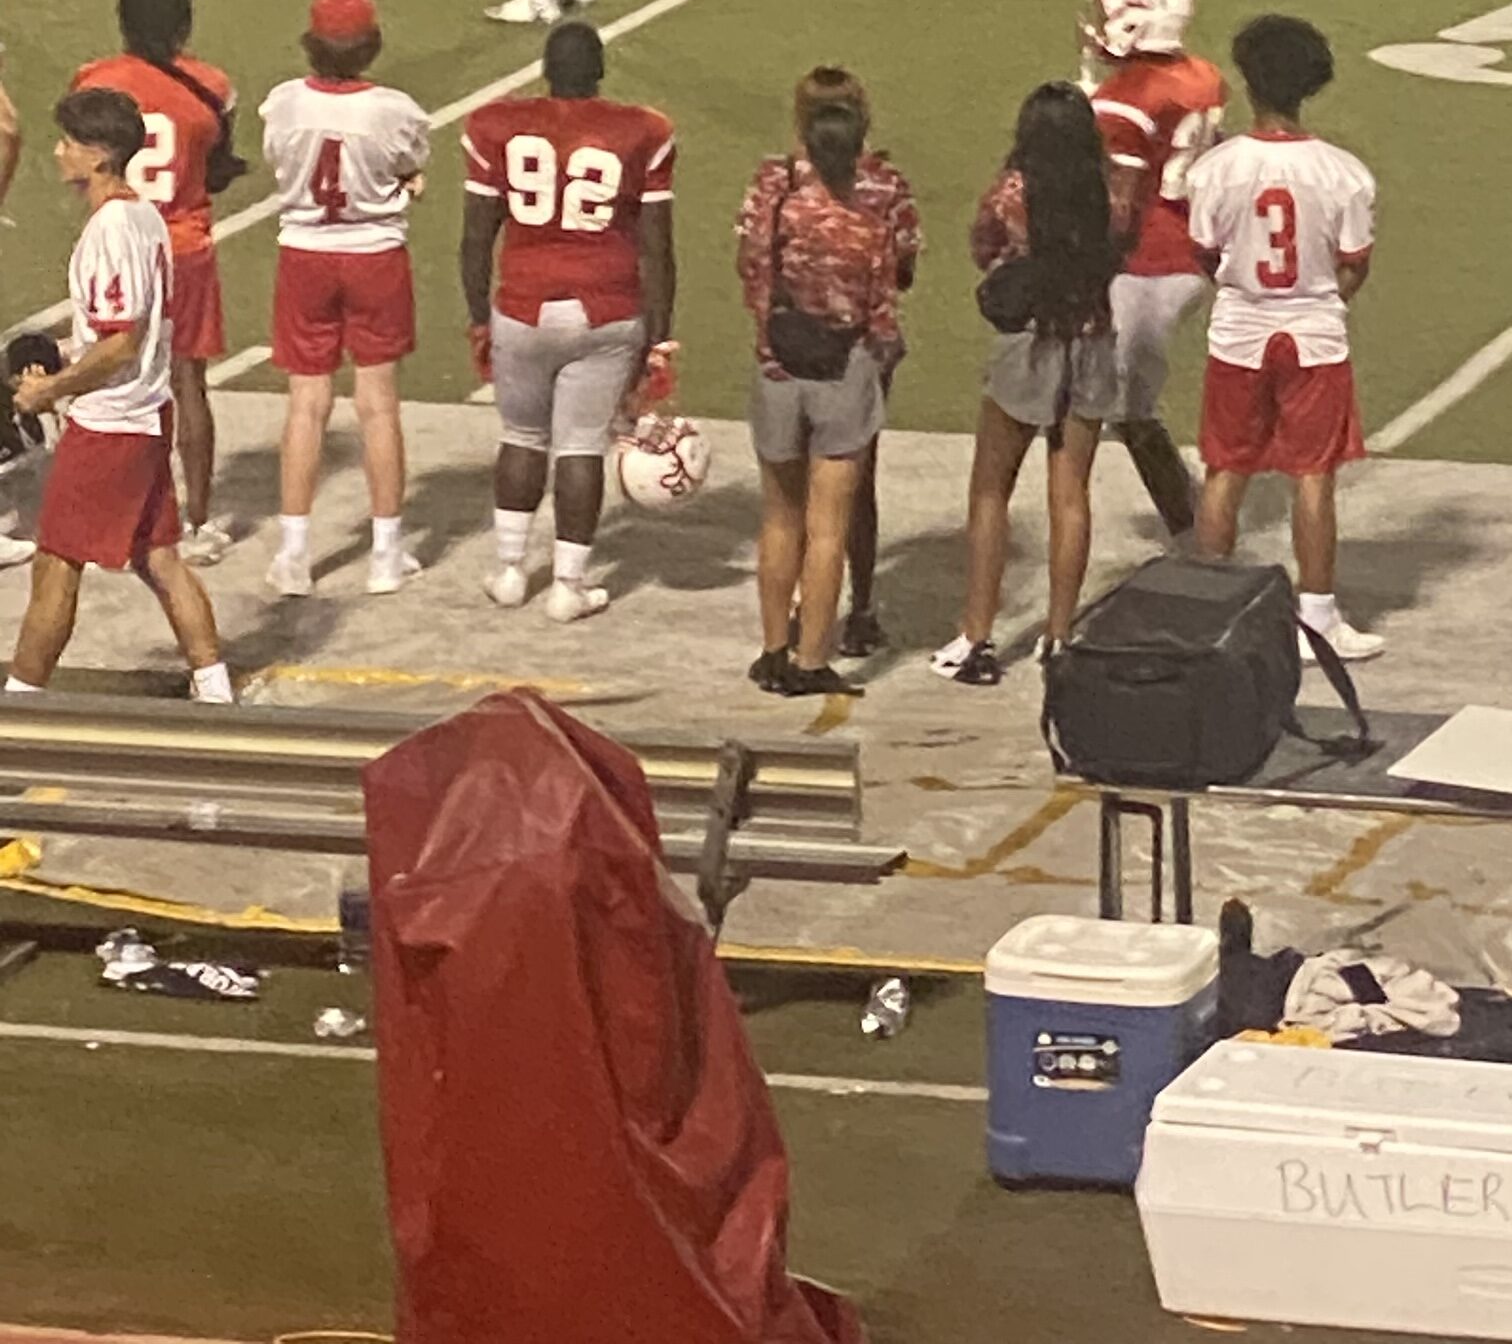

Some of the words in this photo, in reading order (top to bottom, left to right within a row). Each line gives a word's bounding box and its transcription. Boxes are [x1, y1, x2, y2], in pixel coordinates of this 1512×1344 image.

[310, 137, 347, 224] 4
[506, 135, 623, 232] 92
[1256, 188, 1299, 289] 3
[87, 273, 124, 315] 14
[1276, 1159, 1510, 1222] BUTLER
